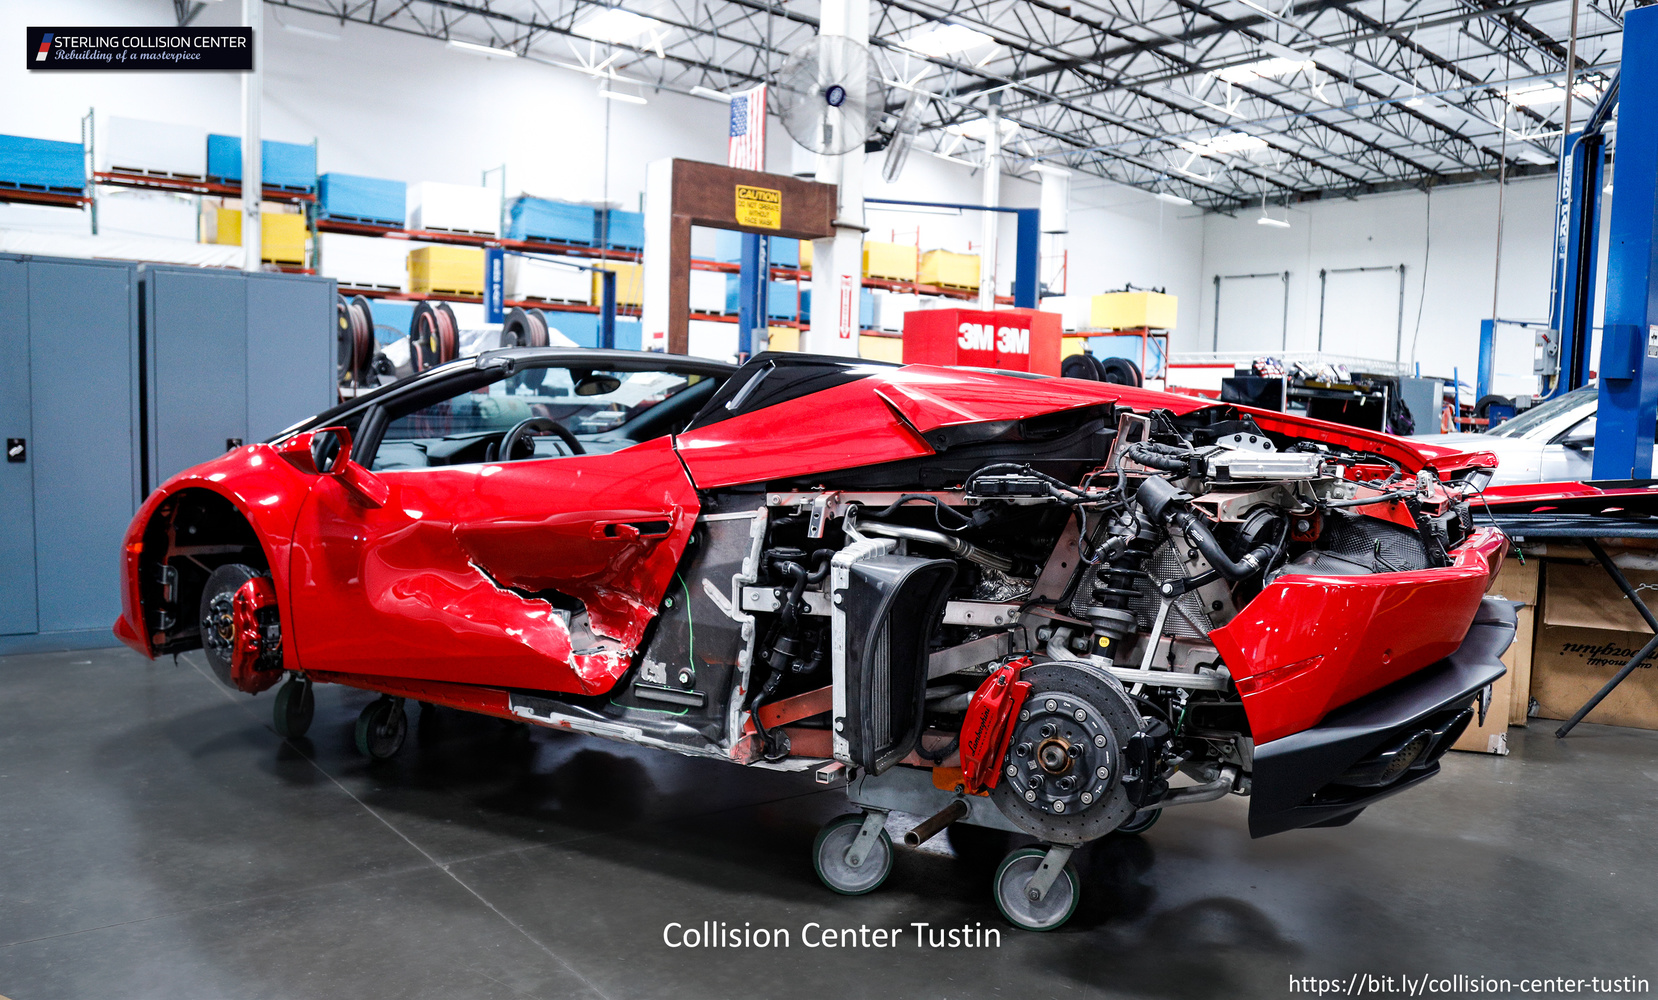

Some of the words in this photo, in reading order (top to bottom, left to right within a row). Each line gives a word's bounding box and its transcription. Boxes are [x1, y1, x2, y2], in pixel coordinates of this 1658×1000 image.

[739, 188, 779, 203] CAUTION
[958, 322, 994, 351] 3M
[997, 326, 1030, 354] 3M
[968, 705, 990, 757] Lamborghini
